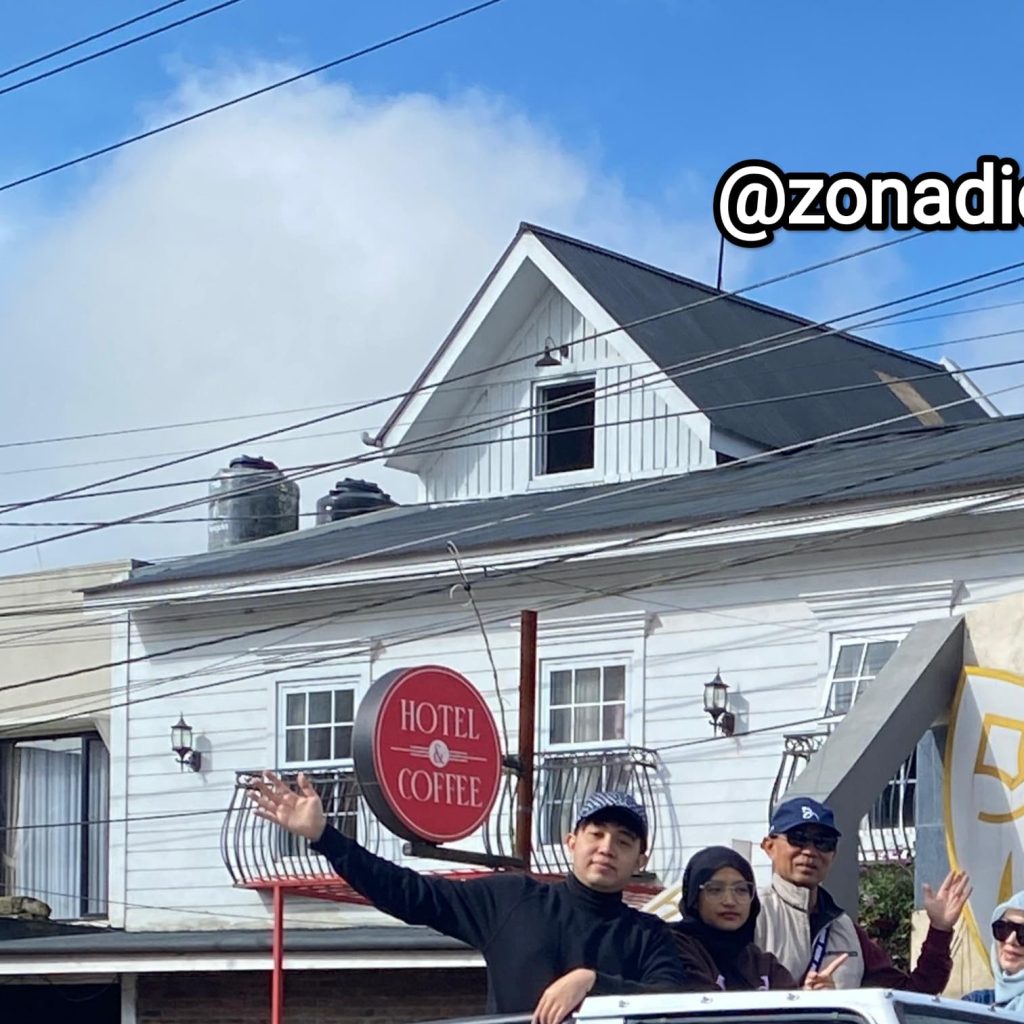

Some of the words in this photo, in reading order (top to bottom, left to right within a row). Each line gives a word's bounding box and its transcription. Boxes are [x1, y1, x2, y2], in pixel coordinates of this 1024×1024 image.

[400, 698, 480, 740] HOTEL
[432, 743, 445, 765] &
[398, 767, 483, 808] COFFEE
